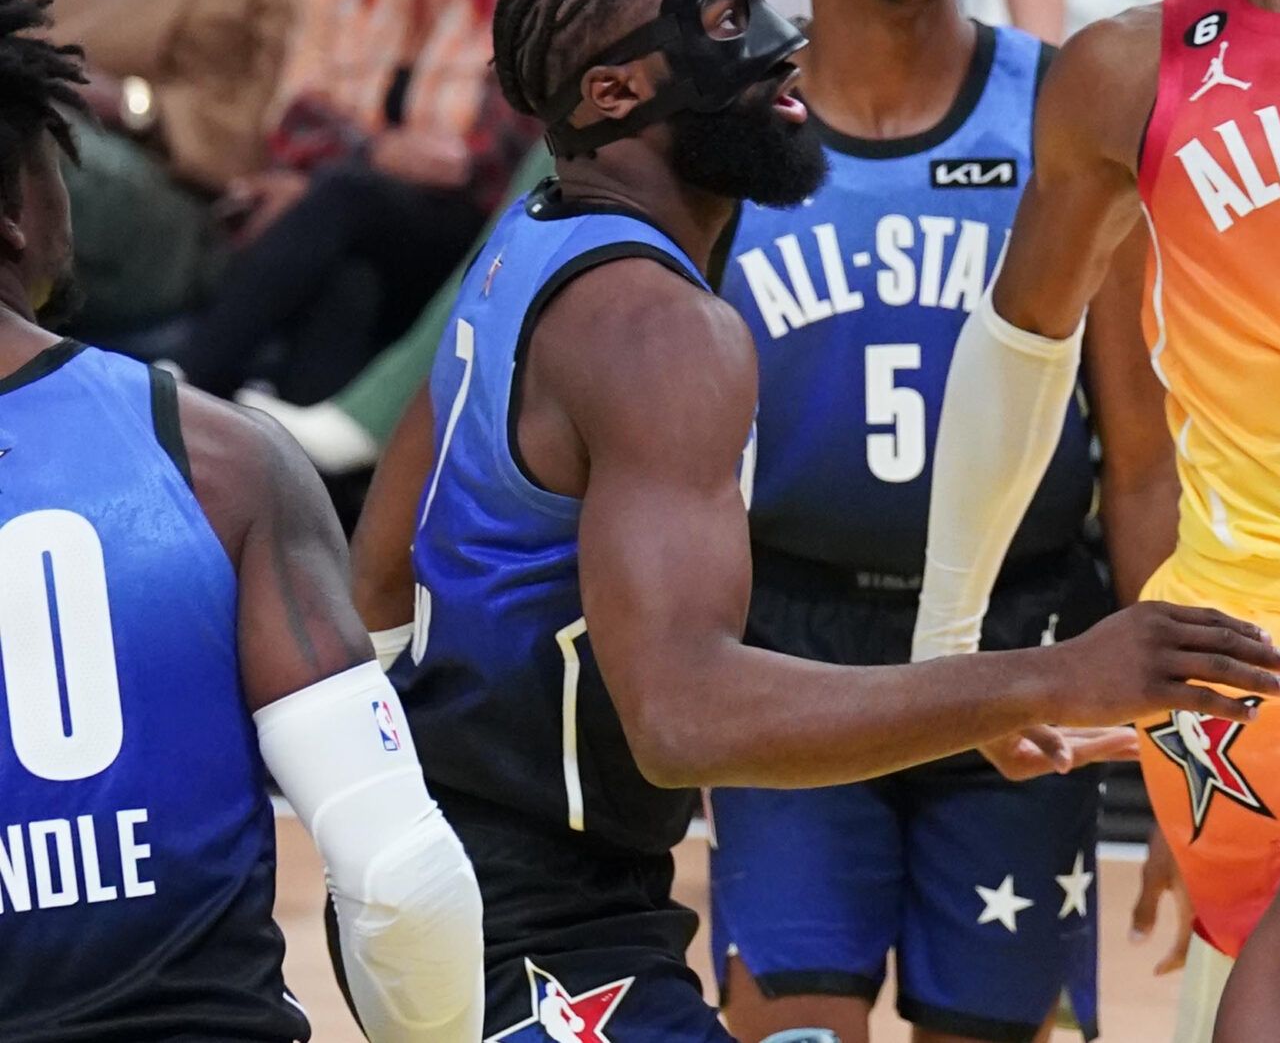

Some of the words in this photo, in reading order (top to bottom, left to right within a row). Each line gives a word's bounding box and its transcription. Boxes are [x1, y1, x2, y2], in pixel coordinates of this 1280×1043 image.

[1193, 13, 1220, 46] 6
[936, 161, 1013, 185] KIA
[736, 213, 1012, 339] ALL-STA
[864, 342, 926, 484] 5
